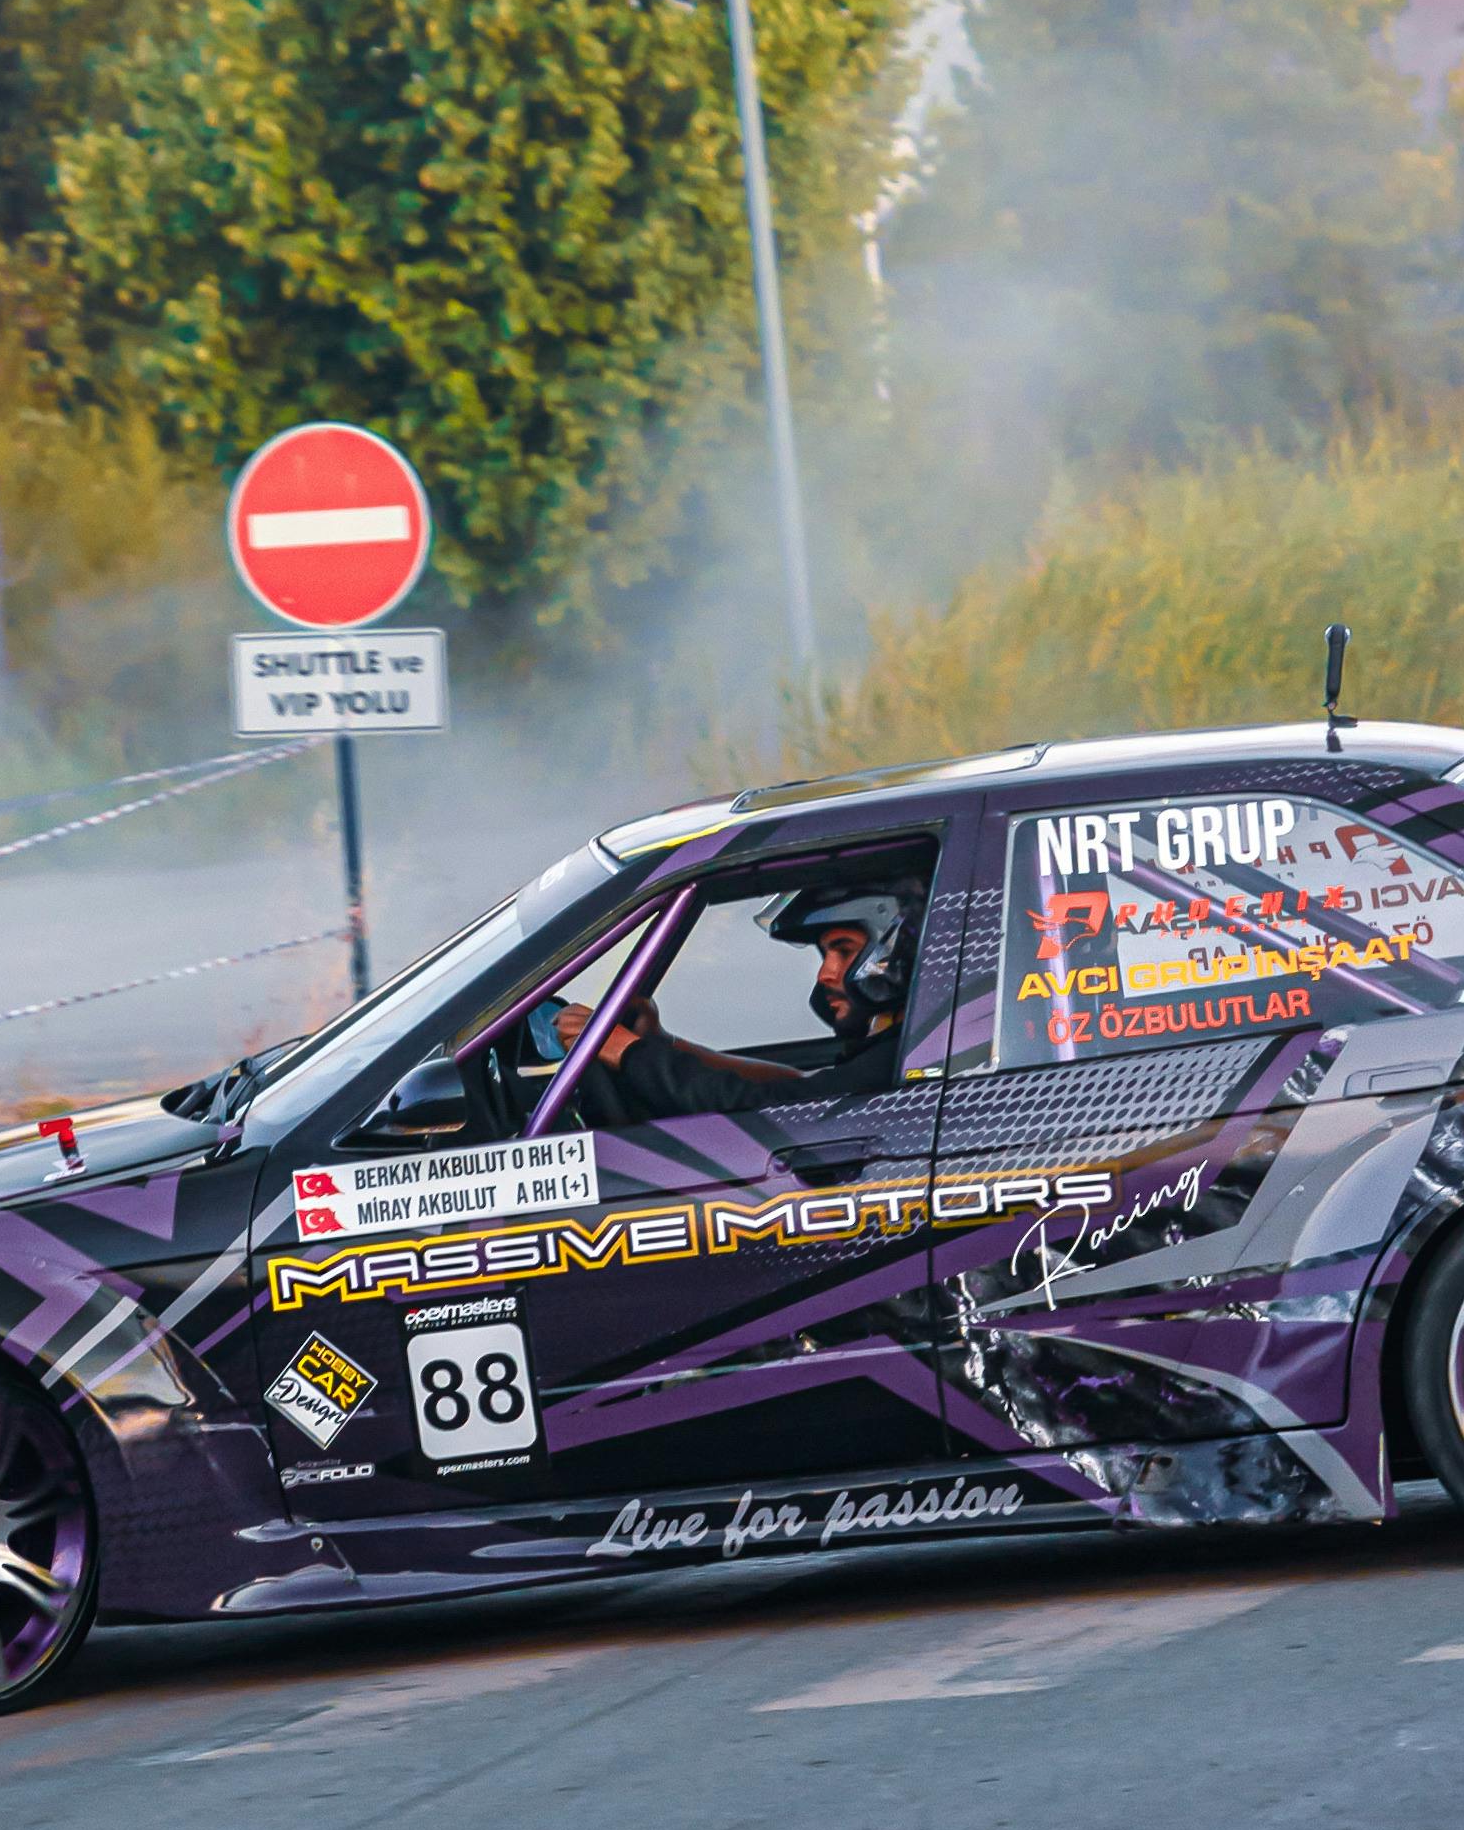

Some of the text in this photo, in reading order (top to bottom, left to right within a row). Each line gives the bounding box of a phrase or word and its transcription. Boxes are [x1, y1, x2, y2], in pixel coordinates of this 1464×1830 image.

[252, 650, 381, 677] SHUTTLE
[269, 690, 410, 717] VIP YOLU
[1037, 811, 1140, 876] NRT
[1156, 799, 1296, 870] GRUP
[1114, 885, 1345, 928] PHOENIX
[1016, 965, 1120, 1001] AVCI
[1126, 954, 1249, 990] GRUP
[1253, 933, 1416, 981] İNŞAAT
[1047, 987, 1312, 1046] ÖZ ÖZBULUTLAR
[354, 1160, 422, 1191] BERKAY
[427, 1150, 507, 1184] AKBULUT
[529, 1144, 553, 1168] RH
[357, 1196, 412, 1225] MİRAY
[418, 1186, 497, 1214] AKBULUT
[516, 1183, 528, 1205] A
[533, 1178, 557, 1202] RH
[278, 1170, 1114, 1302] MASSIVE MOTORS
[1011, 1159, 1208, 1311] Racing
[297, 1354, 357, 1409] CAR
[309, 1340, 368, 1388] HOBBY
[273, 1376, 344, 1426] Design
[419, 1353, 526, 1432] 88
[586, 1477, 1025, 1558] Live for passion
